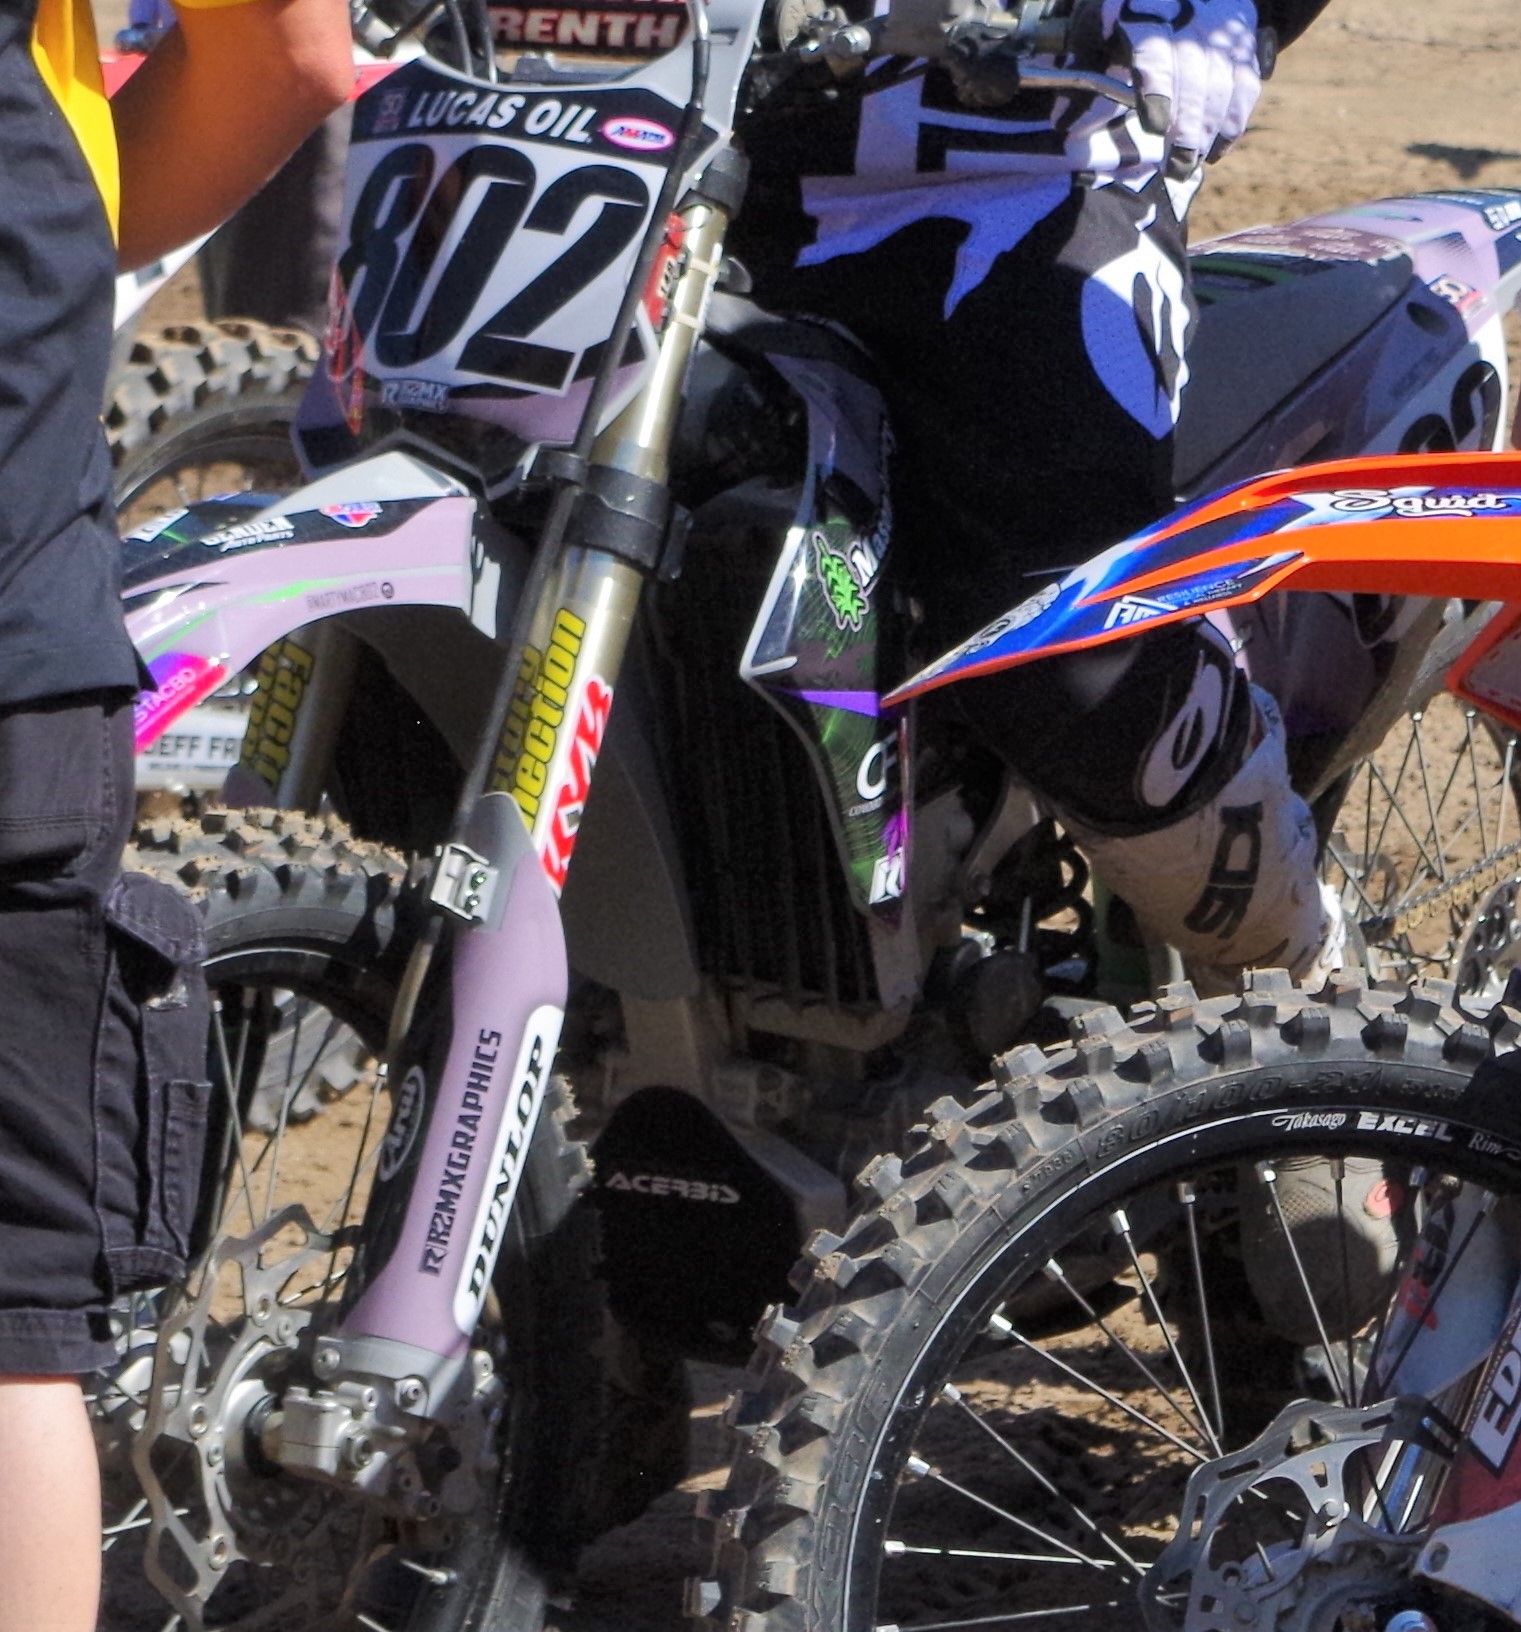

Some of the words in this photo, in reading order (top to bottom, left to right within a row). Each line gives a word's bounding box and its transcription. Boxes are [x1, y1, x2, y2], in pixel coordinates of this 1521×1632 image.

[407, 90, 526, 130] LUCAS
[524, 100, 598, 142] OIL
[339, 142, 651, 391] 802
[1271, 1111, 1347, 1132] Takasago
[1356, 1111, 1454, 1144] EXCEL
[1466, 1131, 1504, 1156] Rim
[467, 1033, 544, 1304] DUNLOP
[604, 1171, 741, 1204] ACERBIS
